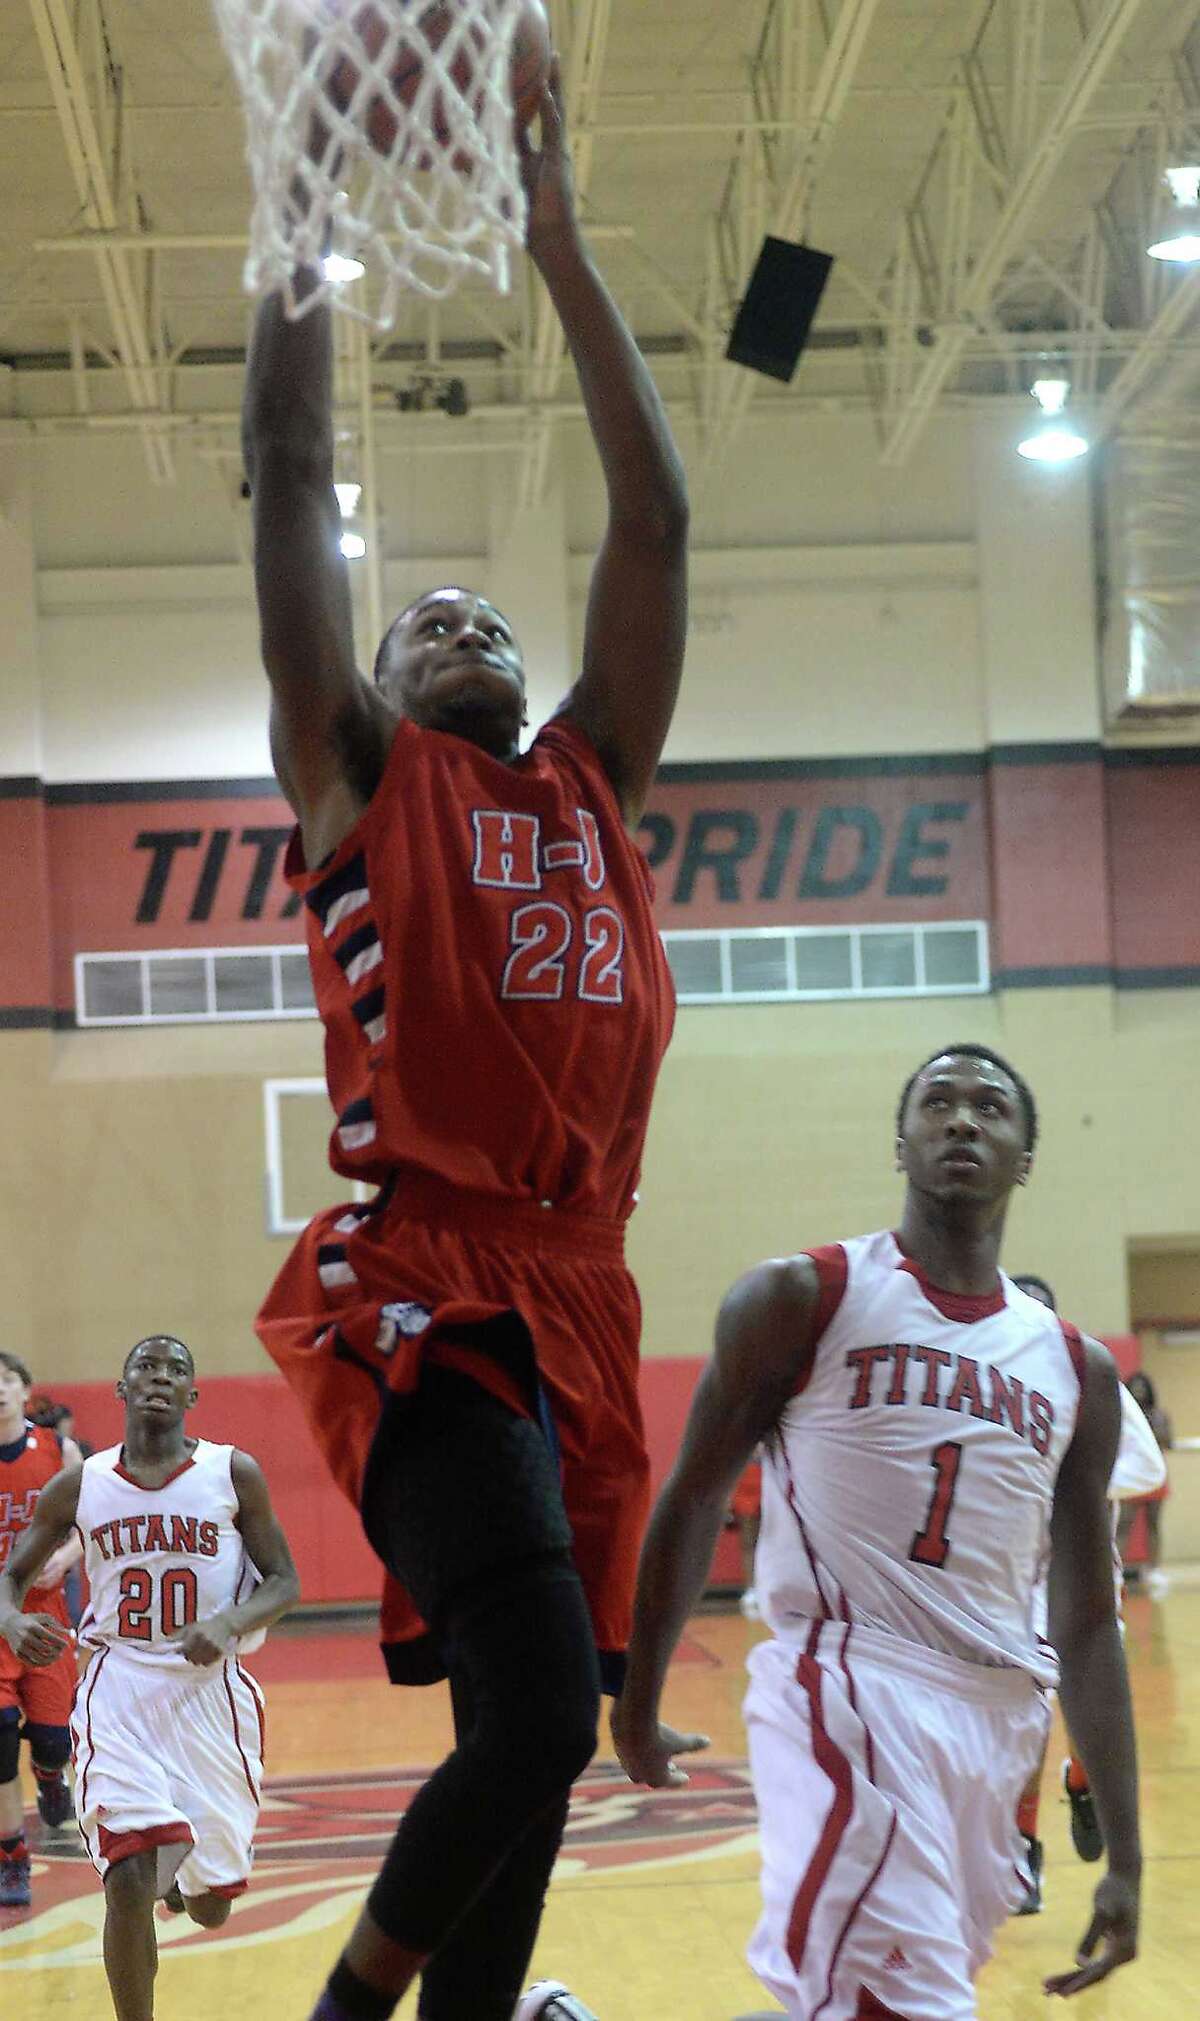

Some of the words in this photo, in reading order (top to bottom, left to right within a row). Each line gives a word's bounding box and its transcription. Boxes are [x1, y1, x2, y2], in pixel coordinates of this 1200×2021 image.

[501, 901, 624, 1004] 22
[846, 1342, 1054, 1456] TITANS
[90, 1514, 219, 1561] TITANS
[908, 1440, 963, 1570] 1
[117, 1567, 199, 1642] 20
